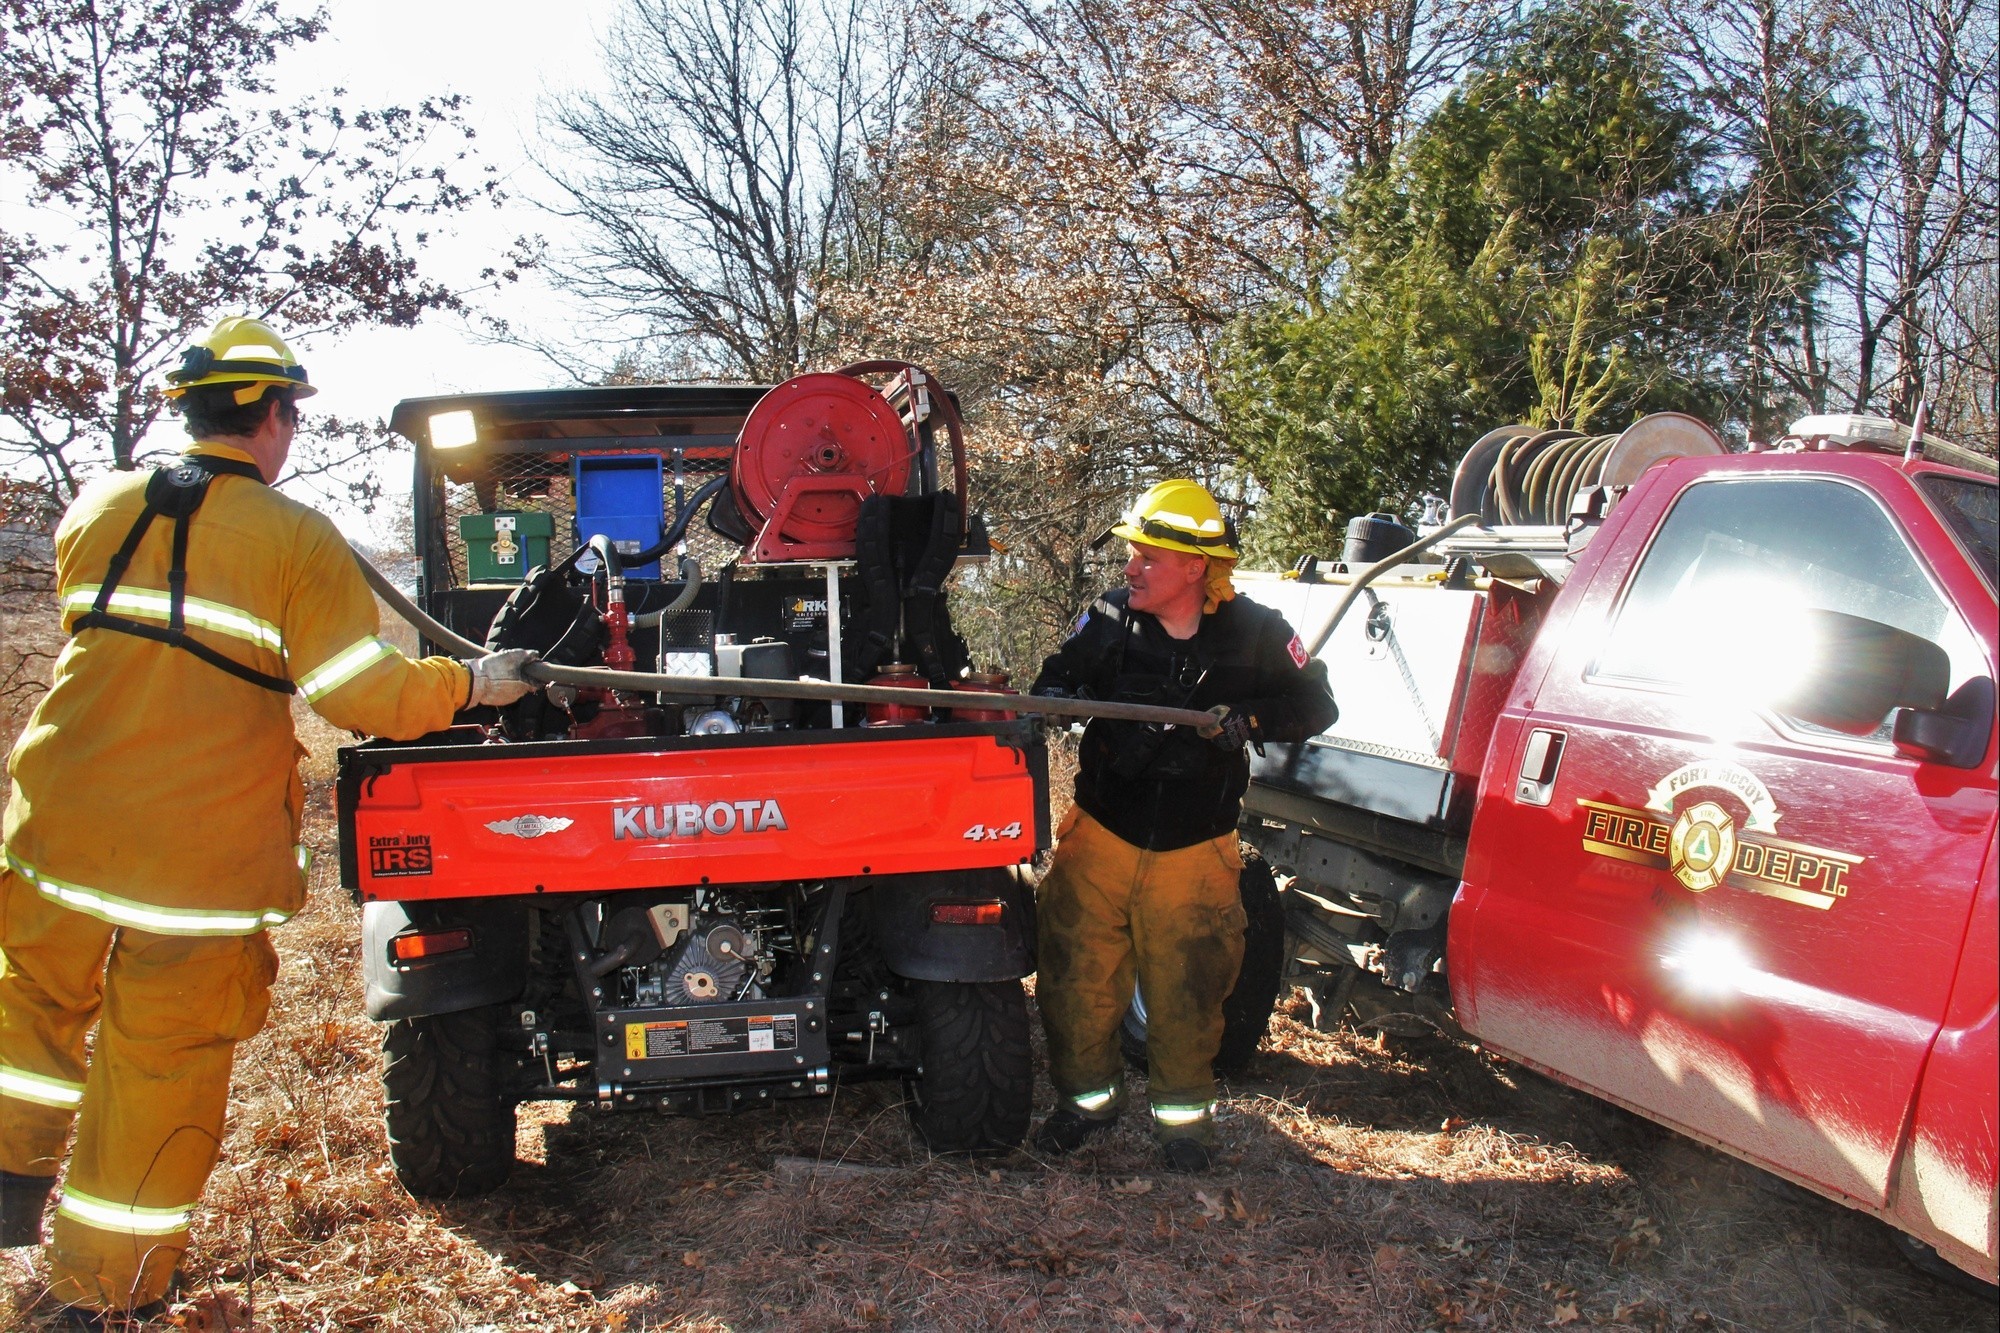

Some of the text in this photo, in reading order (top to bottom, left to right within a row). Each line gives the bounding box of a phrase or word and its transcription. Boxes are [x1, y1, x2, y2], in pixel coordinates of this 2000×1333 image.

[1669, 767, 1709, 791] FORT
[613, 799, 788, 840] KUBOTA
[370, 836, 399, 847] Extra
[963, 822, 1021, 841] 4x4
[373, 848, 430, 870] IRS
[1584, 810, 1670, 853] FIRE
[1732, 841, 1849, 897] DEPT.
